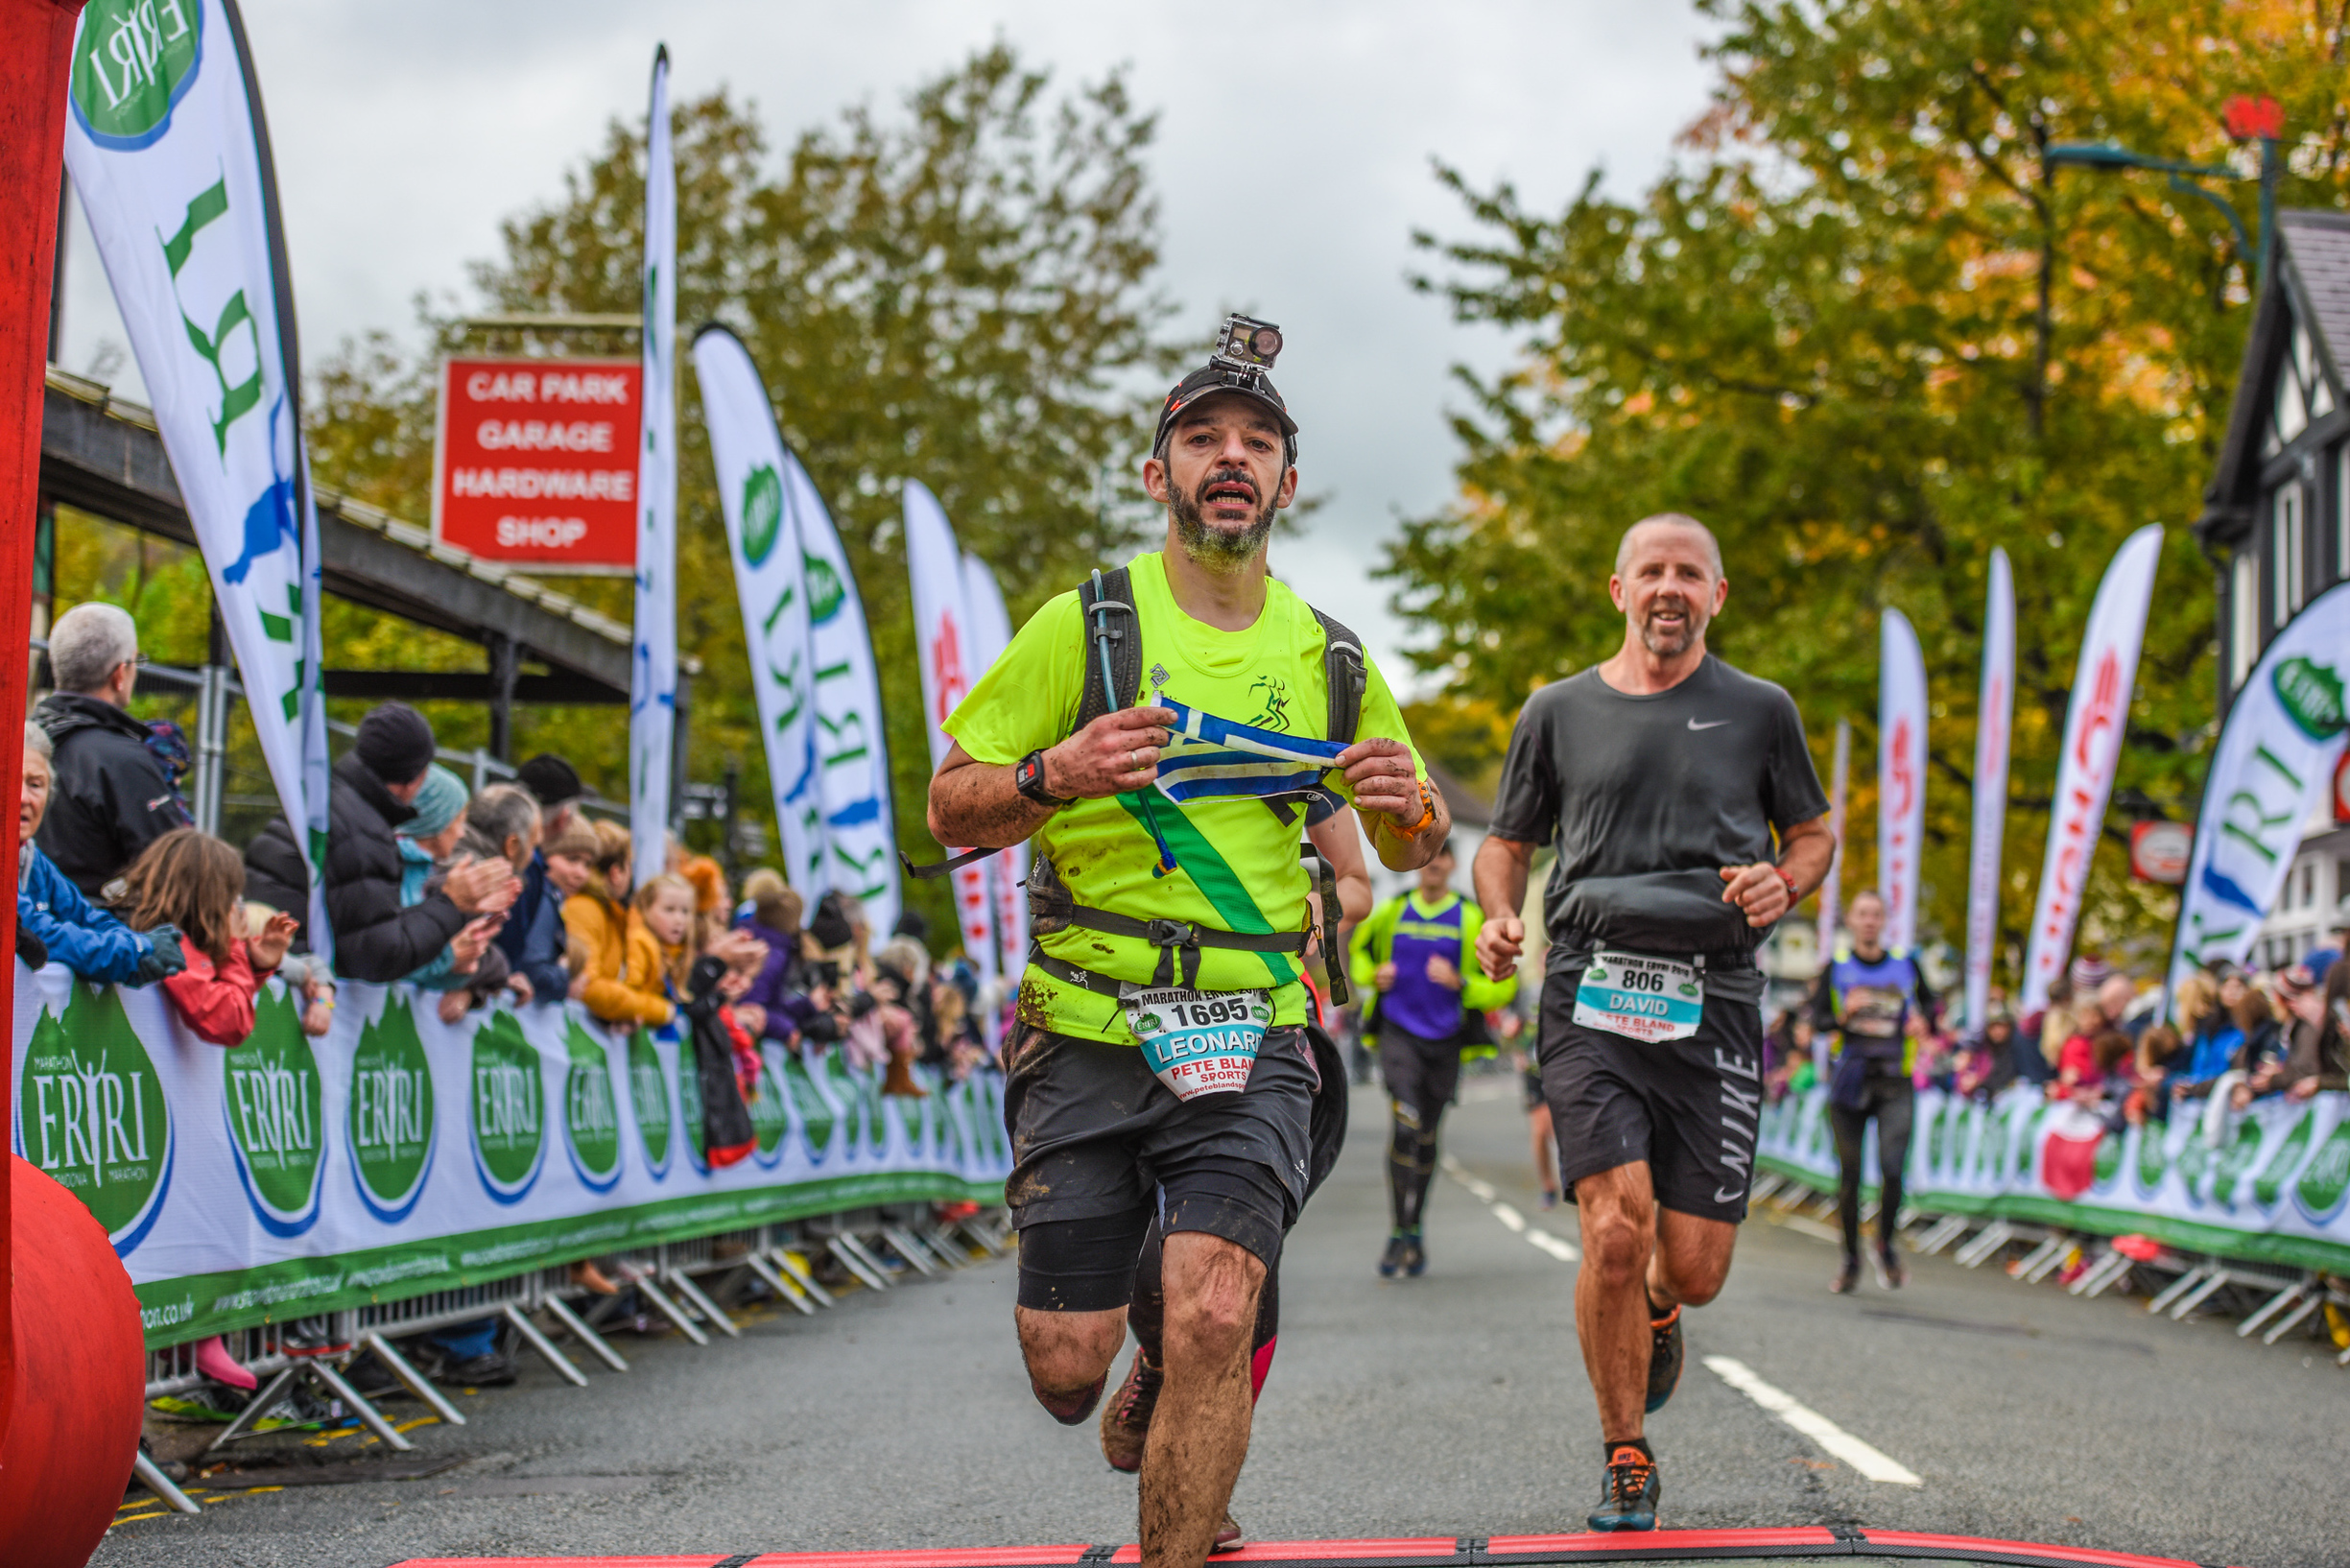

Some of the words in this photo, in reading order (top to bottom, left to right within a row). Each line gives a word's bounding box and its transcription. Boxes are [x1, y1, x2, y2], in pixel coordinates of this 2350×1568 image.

[466, 371, 536, 403] CAR
[540, 372, 629, 405] PARK
[477, 419, 615, 452] GARAGE
[452, 466, 635, 502] HARDWARE
[496, 515, 587, 548] SHOP
[1622, 969, 1664, 992] 806
[1142, 989, 1202, 1006] MARATHON
[1610, 994, 1669, 1016] DAVID
[1172, 998, 1247, 1026] 1695
[1633, 1017, 1675, 1033] BLAND
[34, 1056, 74, 1071] MARATHON
[1171, 1059, 1215, 1081] PETE
[1199, 1070, 1246, 1082] SPORTS
[1714, 1047, 1761, 1179] NIKE
[107, 1167, 149, 1183] MARATHON
